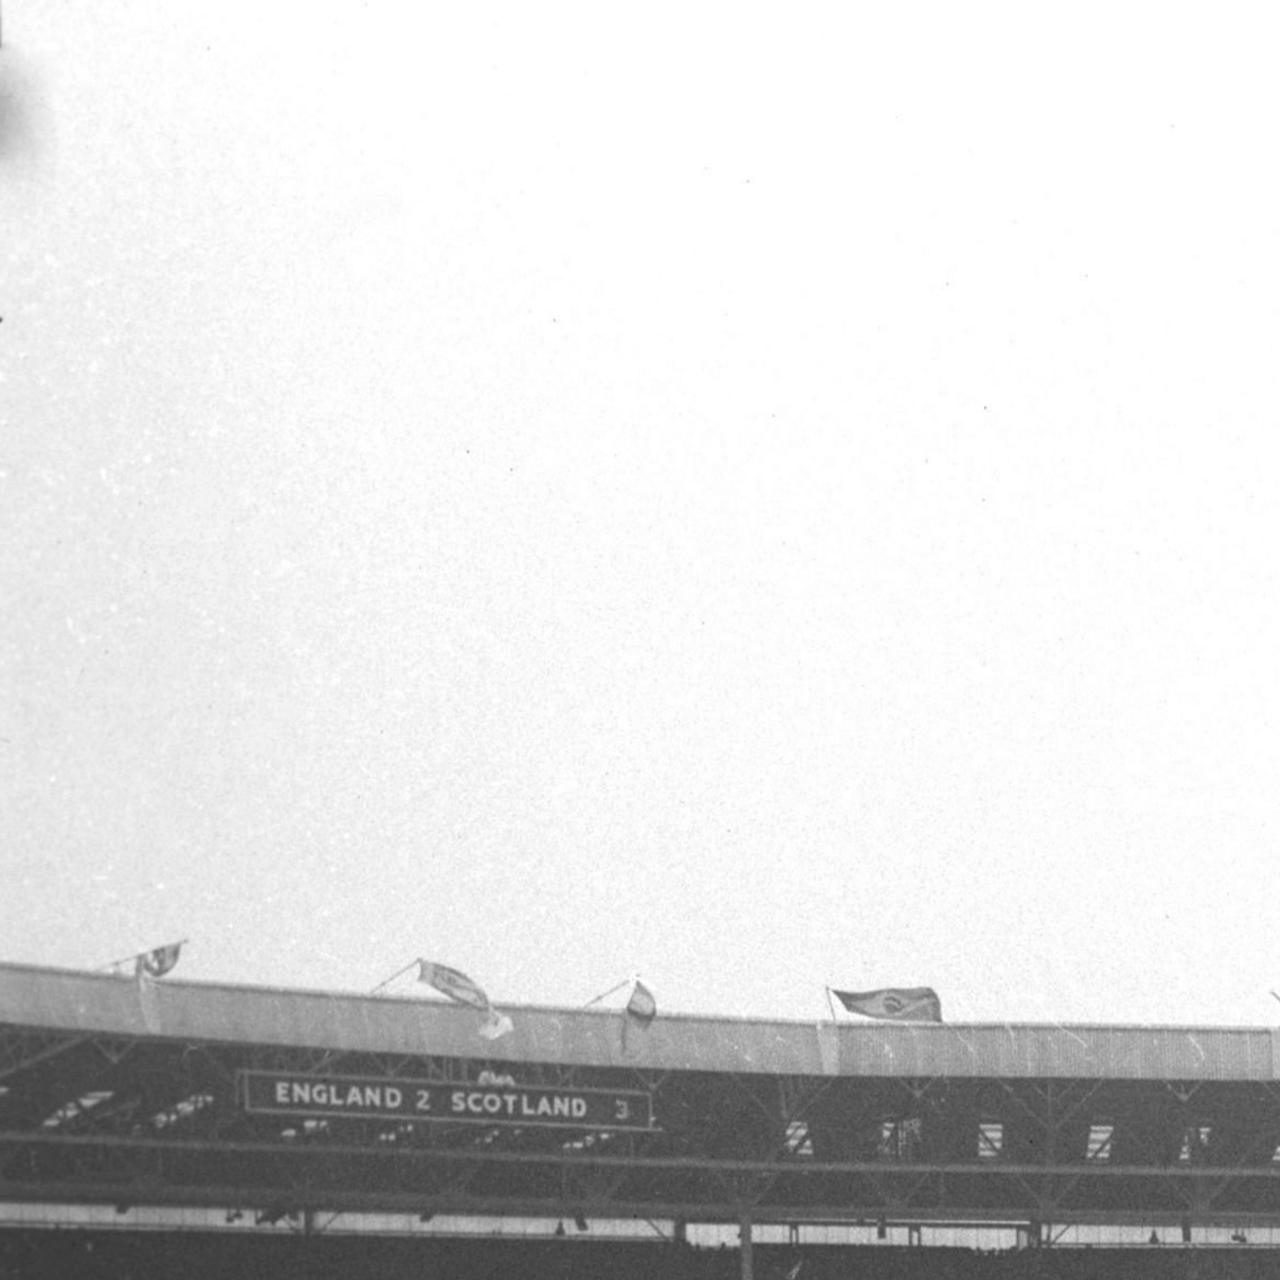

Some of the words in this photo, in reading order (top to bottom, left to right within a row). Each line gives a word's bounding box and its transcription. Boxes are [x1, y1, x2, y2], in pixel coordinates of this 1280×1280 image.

[276, 1082, 402, 1109] ENGLAND
[416, 1090, 431, 1111] 2
[451, 1092, 587, 1118] SCOTLAND
[616, 1099, 629, 1120] 3
